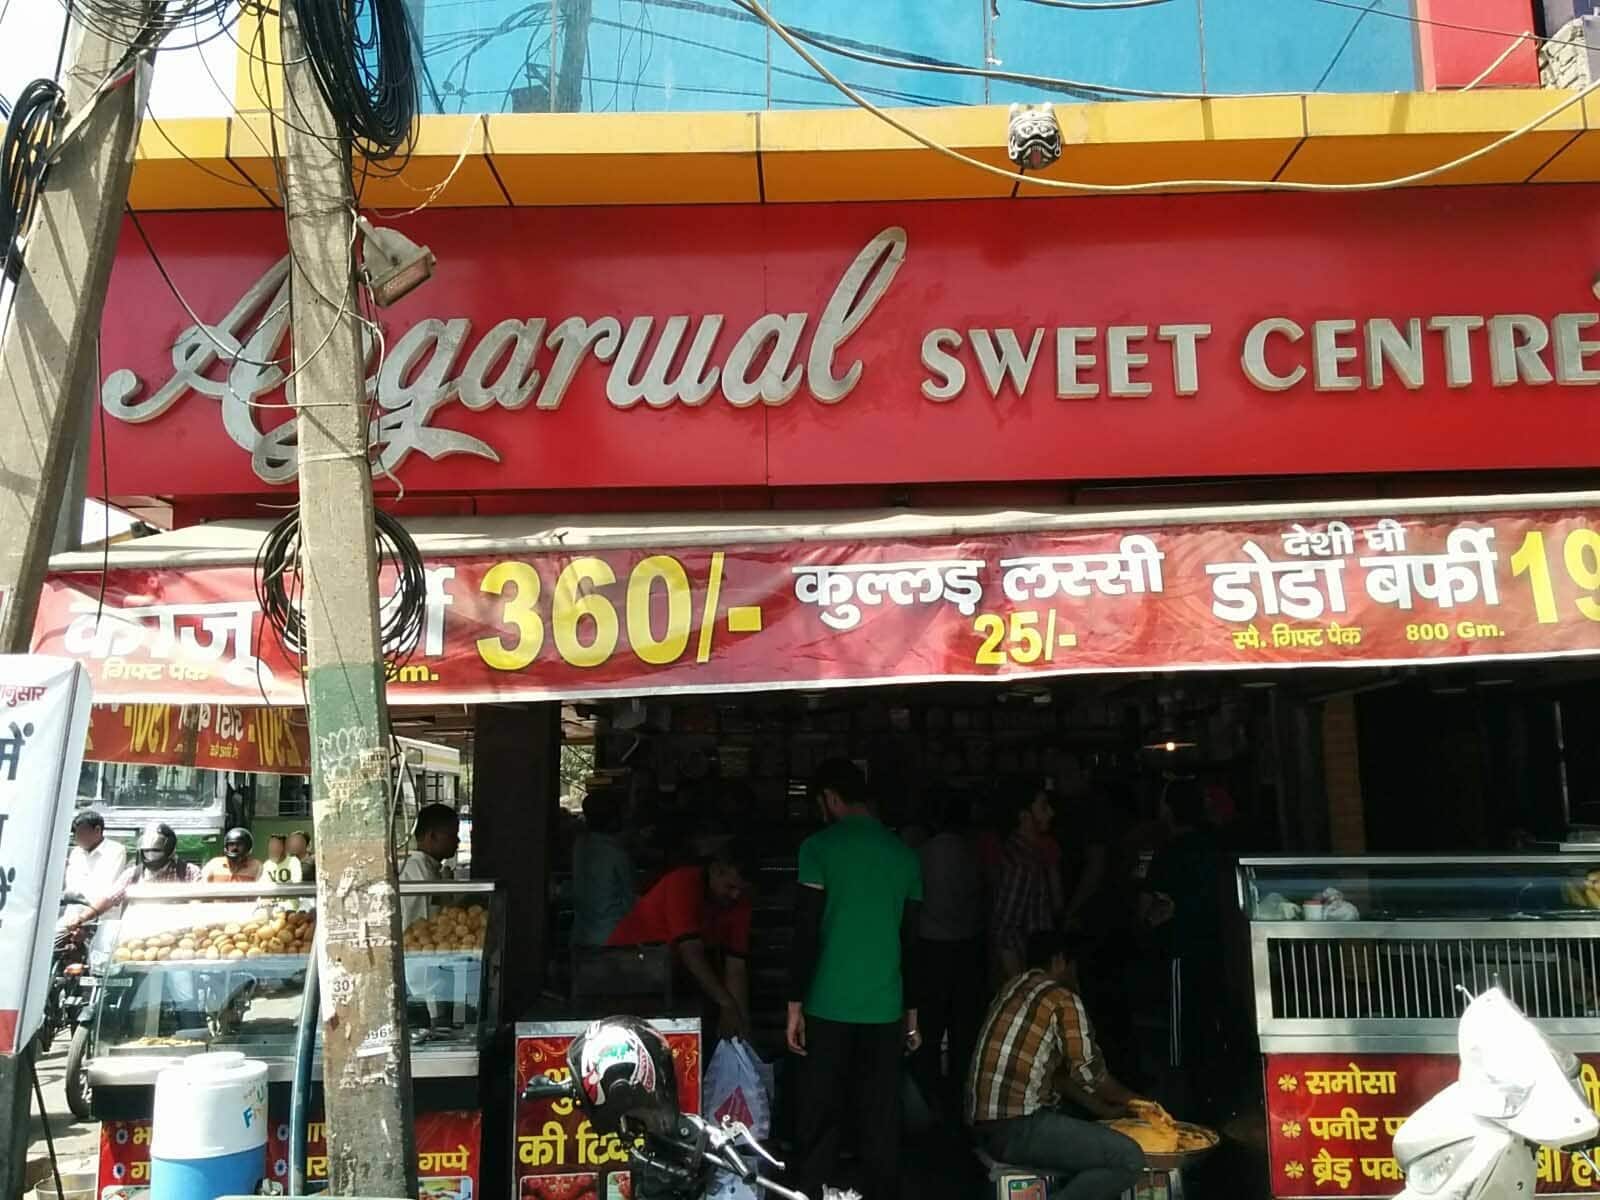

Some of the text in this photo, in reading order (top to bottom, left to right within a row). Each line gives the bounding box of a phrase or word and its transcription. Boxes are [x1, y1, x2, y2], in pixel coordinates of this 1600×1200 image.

[920, 322, 1212, 403] SWEET
[1240, 313, 1600, 391] CENTRE
[1281, 518, 1407, 557] देशी घी
[791, 534, 1165, 630] कुल्लड़ लस्सी
[1206, 526, 1501, 622] डोडा बर्फी
[476, 551, 763, 671] 360/-
[1406, 620, 1506, 643] 800 Gm.
[973, 608, 1078, 666] 25/-
[1272, 623, 1323, 649] गिफ्ट
[1326, 621, 1362, 646] पैक
[1304, 1062, 1397, 1095] समोसा
[517, 1120, 568, 1166] की
[1308, 1107, 1378, 1141] पनीर
[418, 1144, 470, 1173] गप्पे
